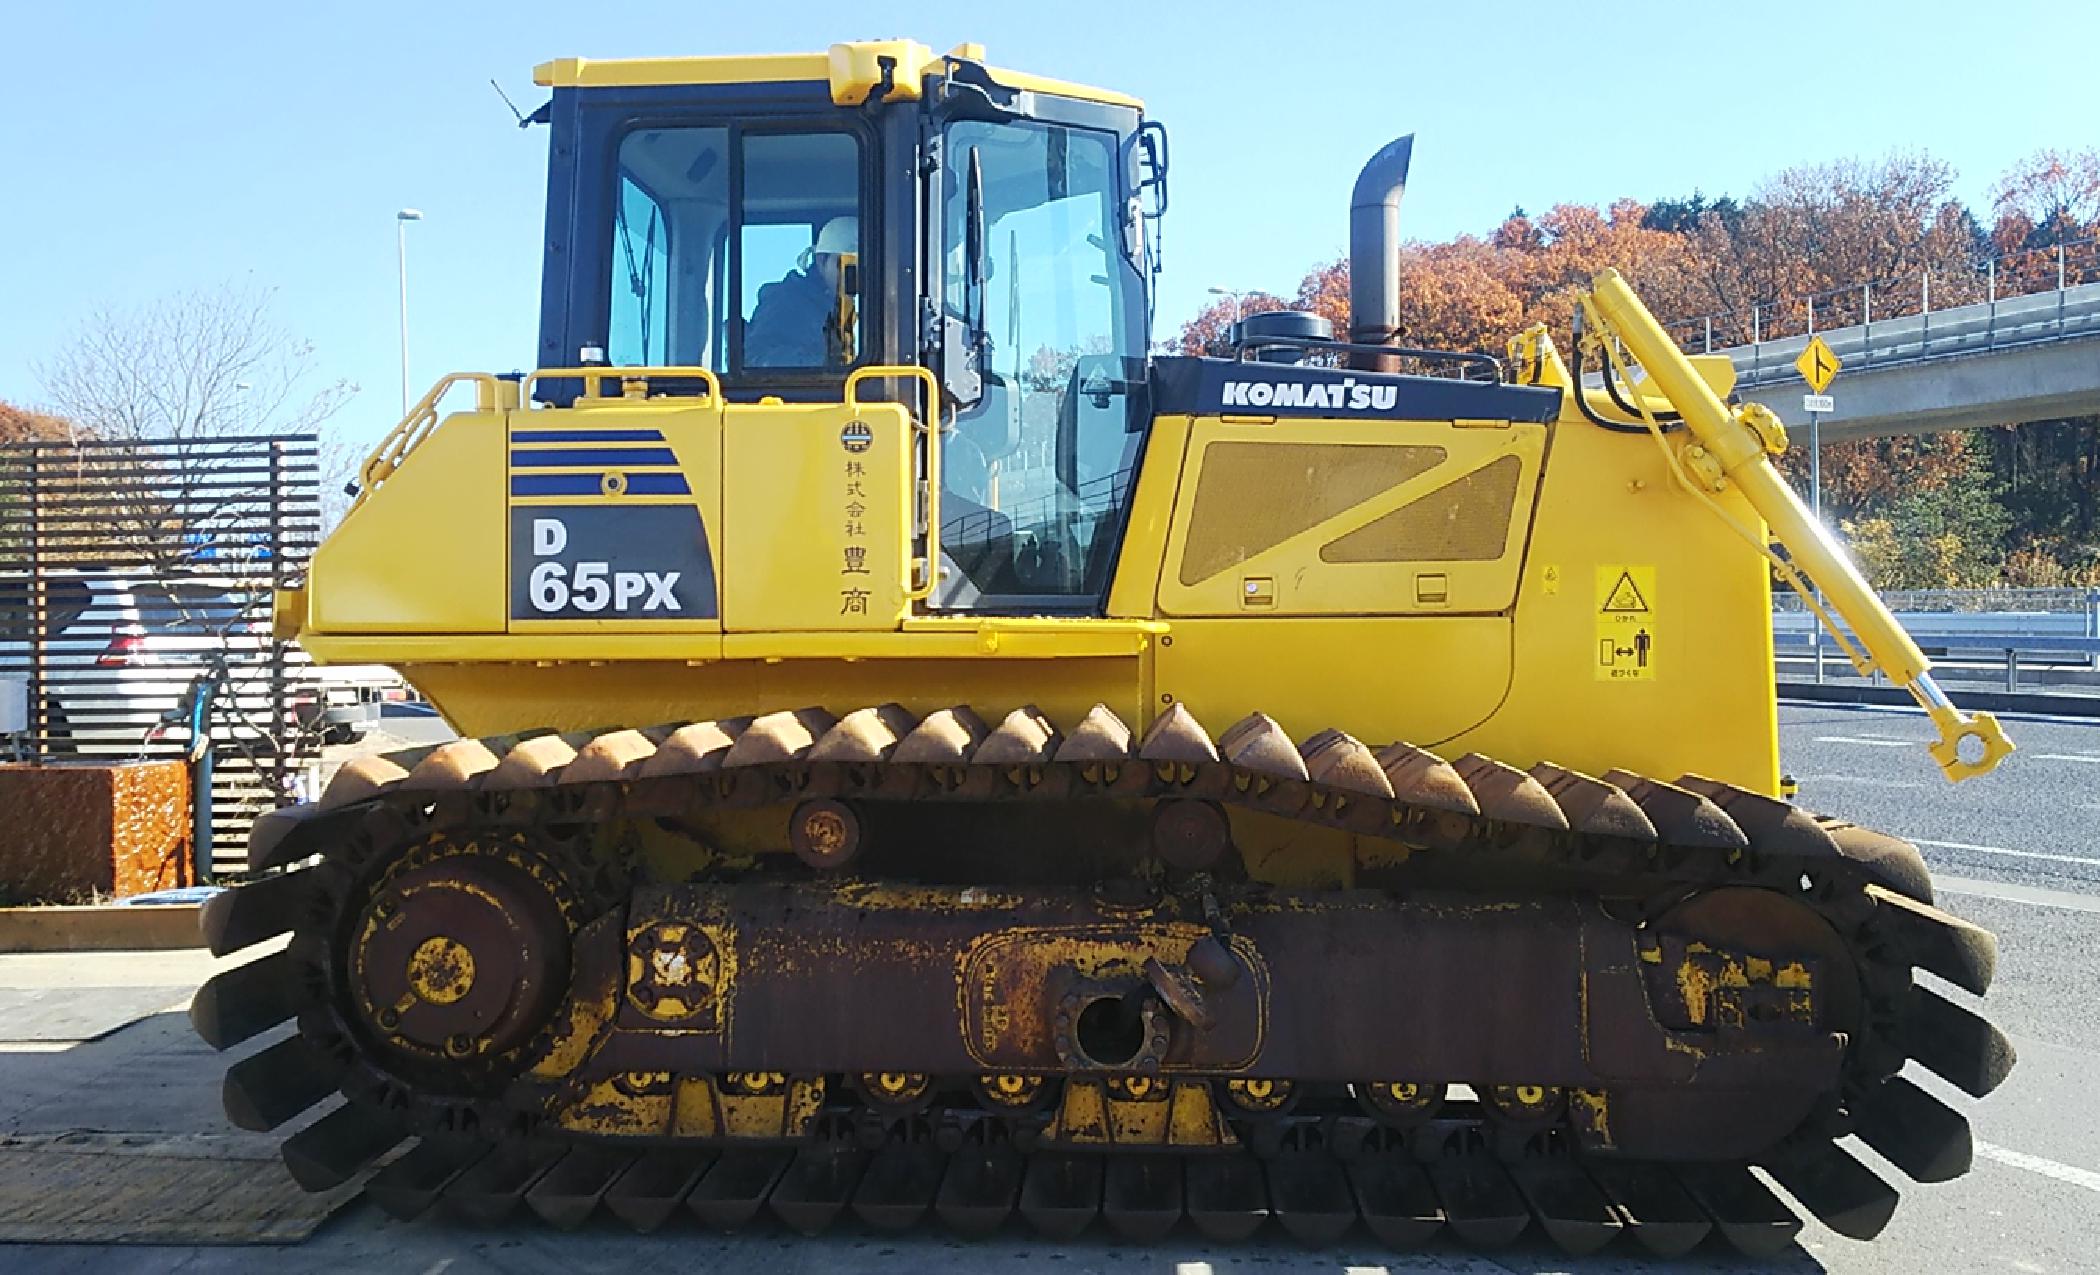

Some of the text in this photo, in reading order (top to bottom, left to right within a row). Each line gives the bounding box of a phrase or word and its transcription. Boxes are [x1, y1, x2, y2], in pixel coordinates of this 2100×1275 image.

[1222, 378, 1398, 410] KOMATSU
[533, 519, 567, 556] D
[529, 561, 682, 612] 65PX
